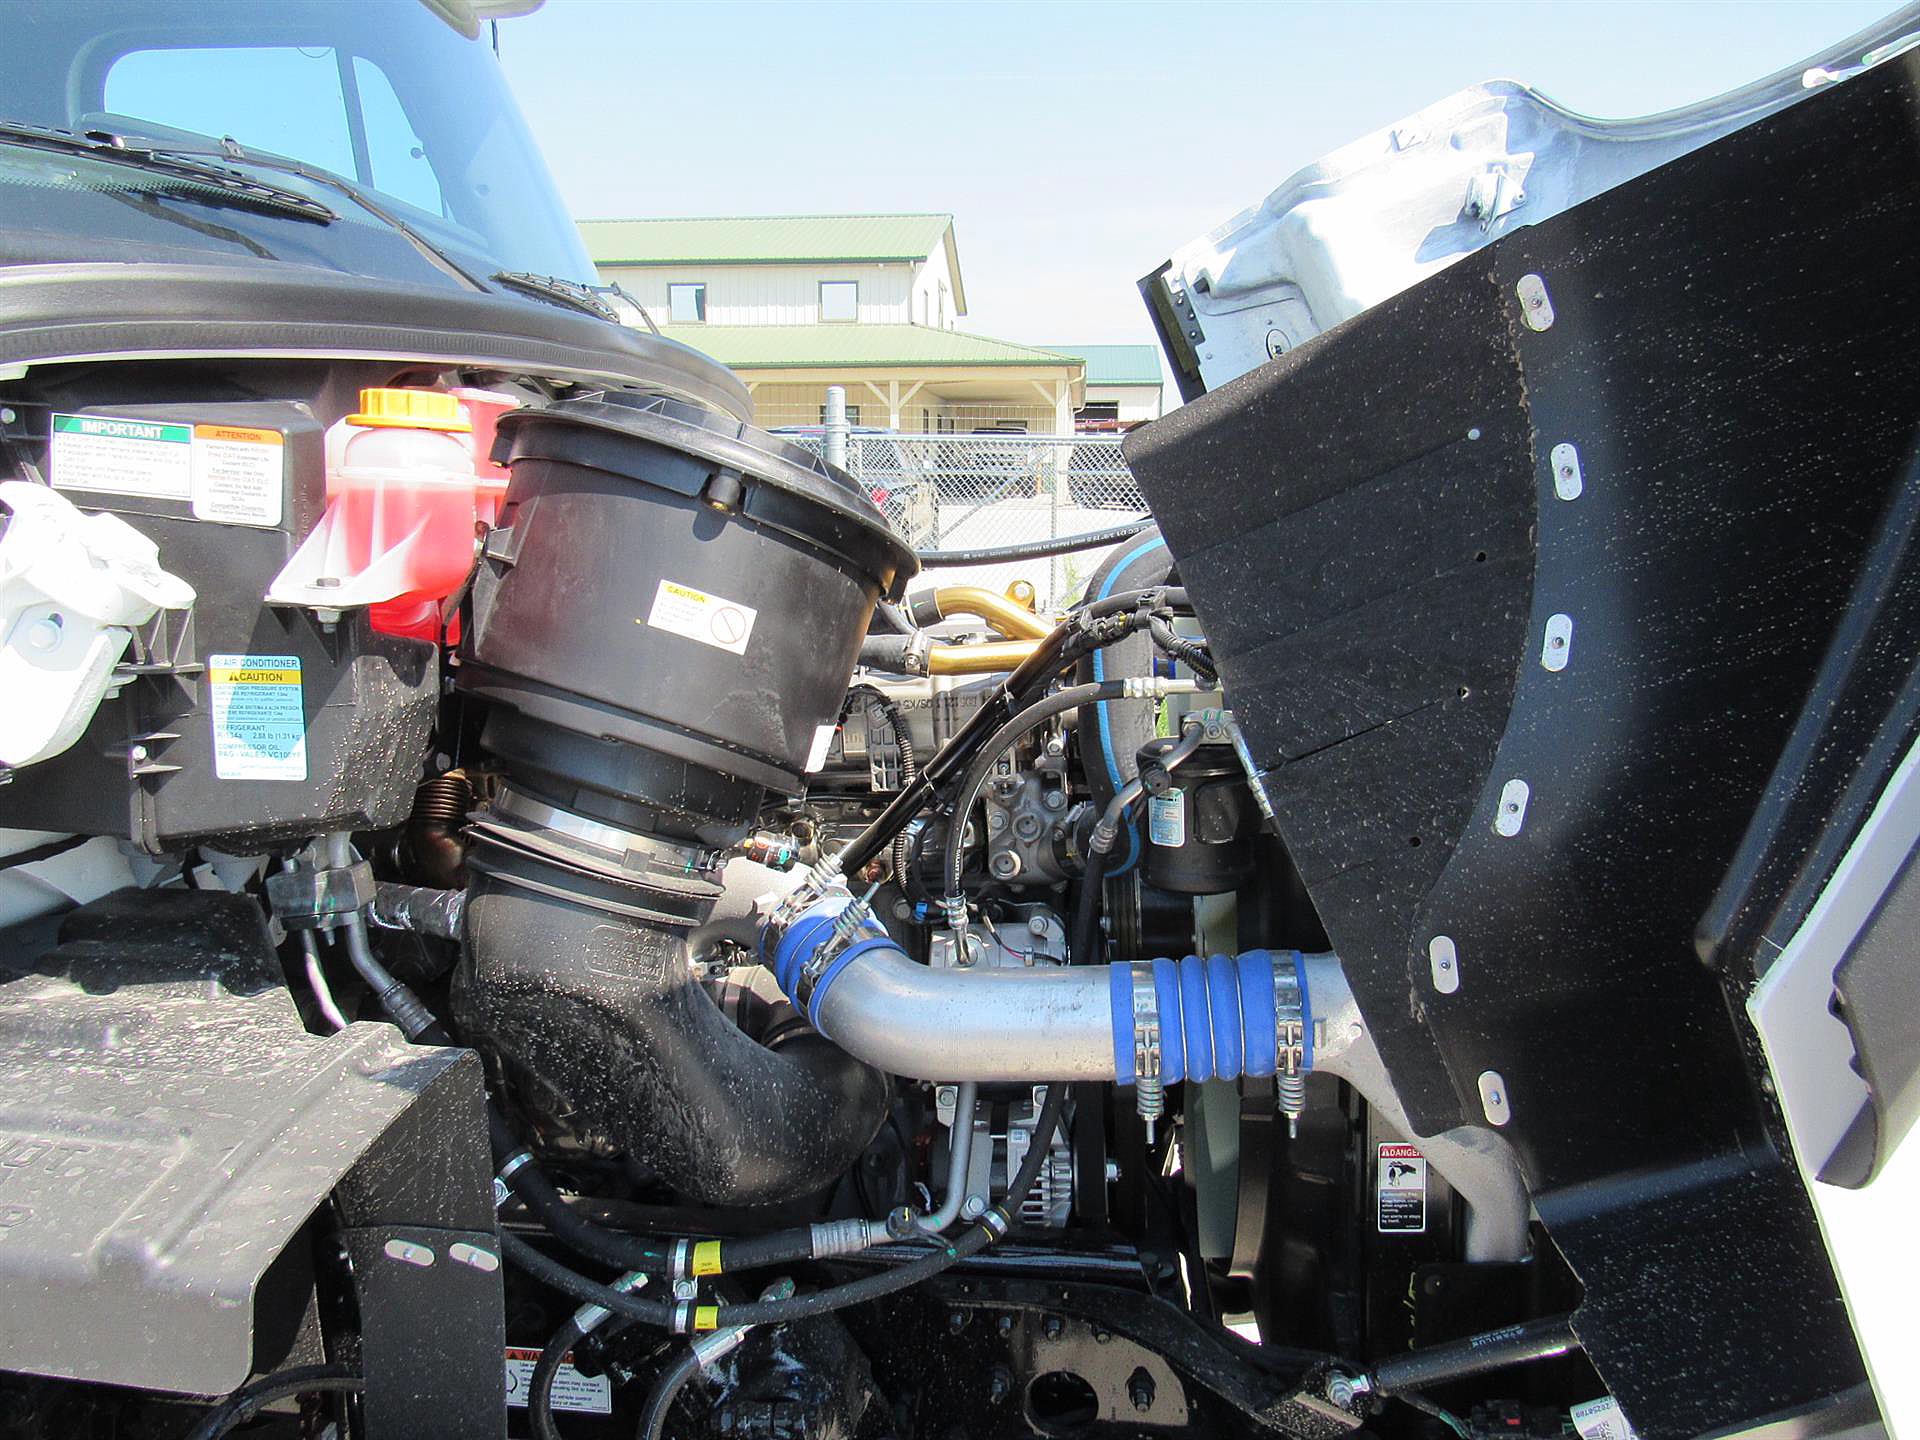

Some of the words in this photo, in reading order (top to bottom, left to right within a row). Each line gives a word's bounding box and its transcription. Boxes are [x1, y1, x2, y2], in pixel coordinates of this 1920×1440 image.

[81, 421, 163, 440] IMPORTANT
[216, 430, 261, 440] ATTENTION
[240, 658, 298, 668] CONDITIONER
[240, 672, 283, 682] CAUTION
